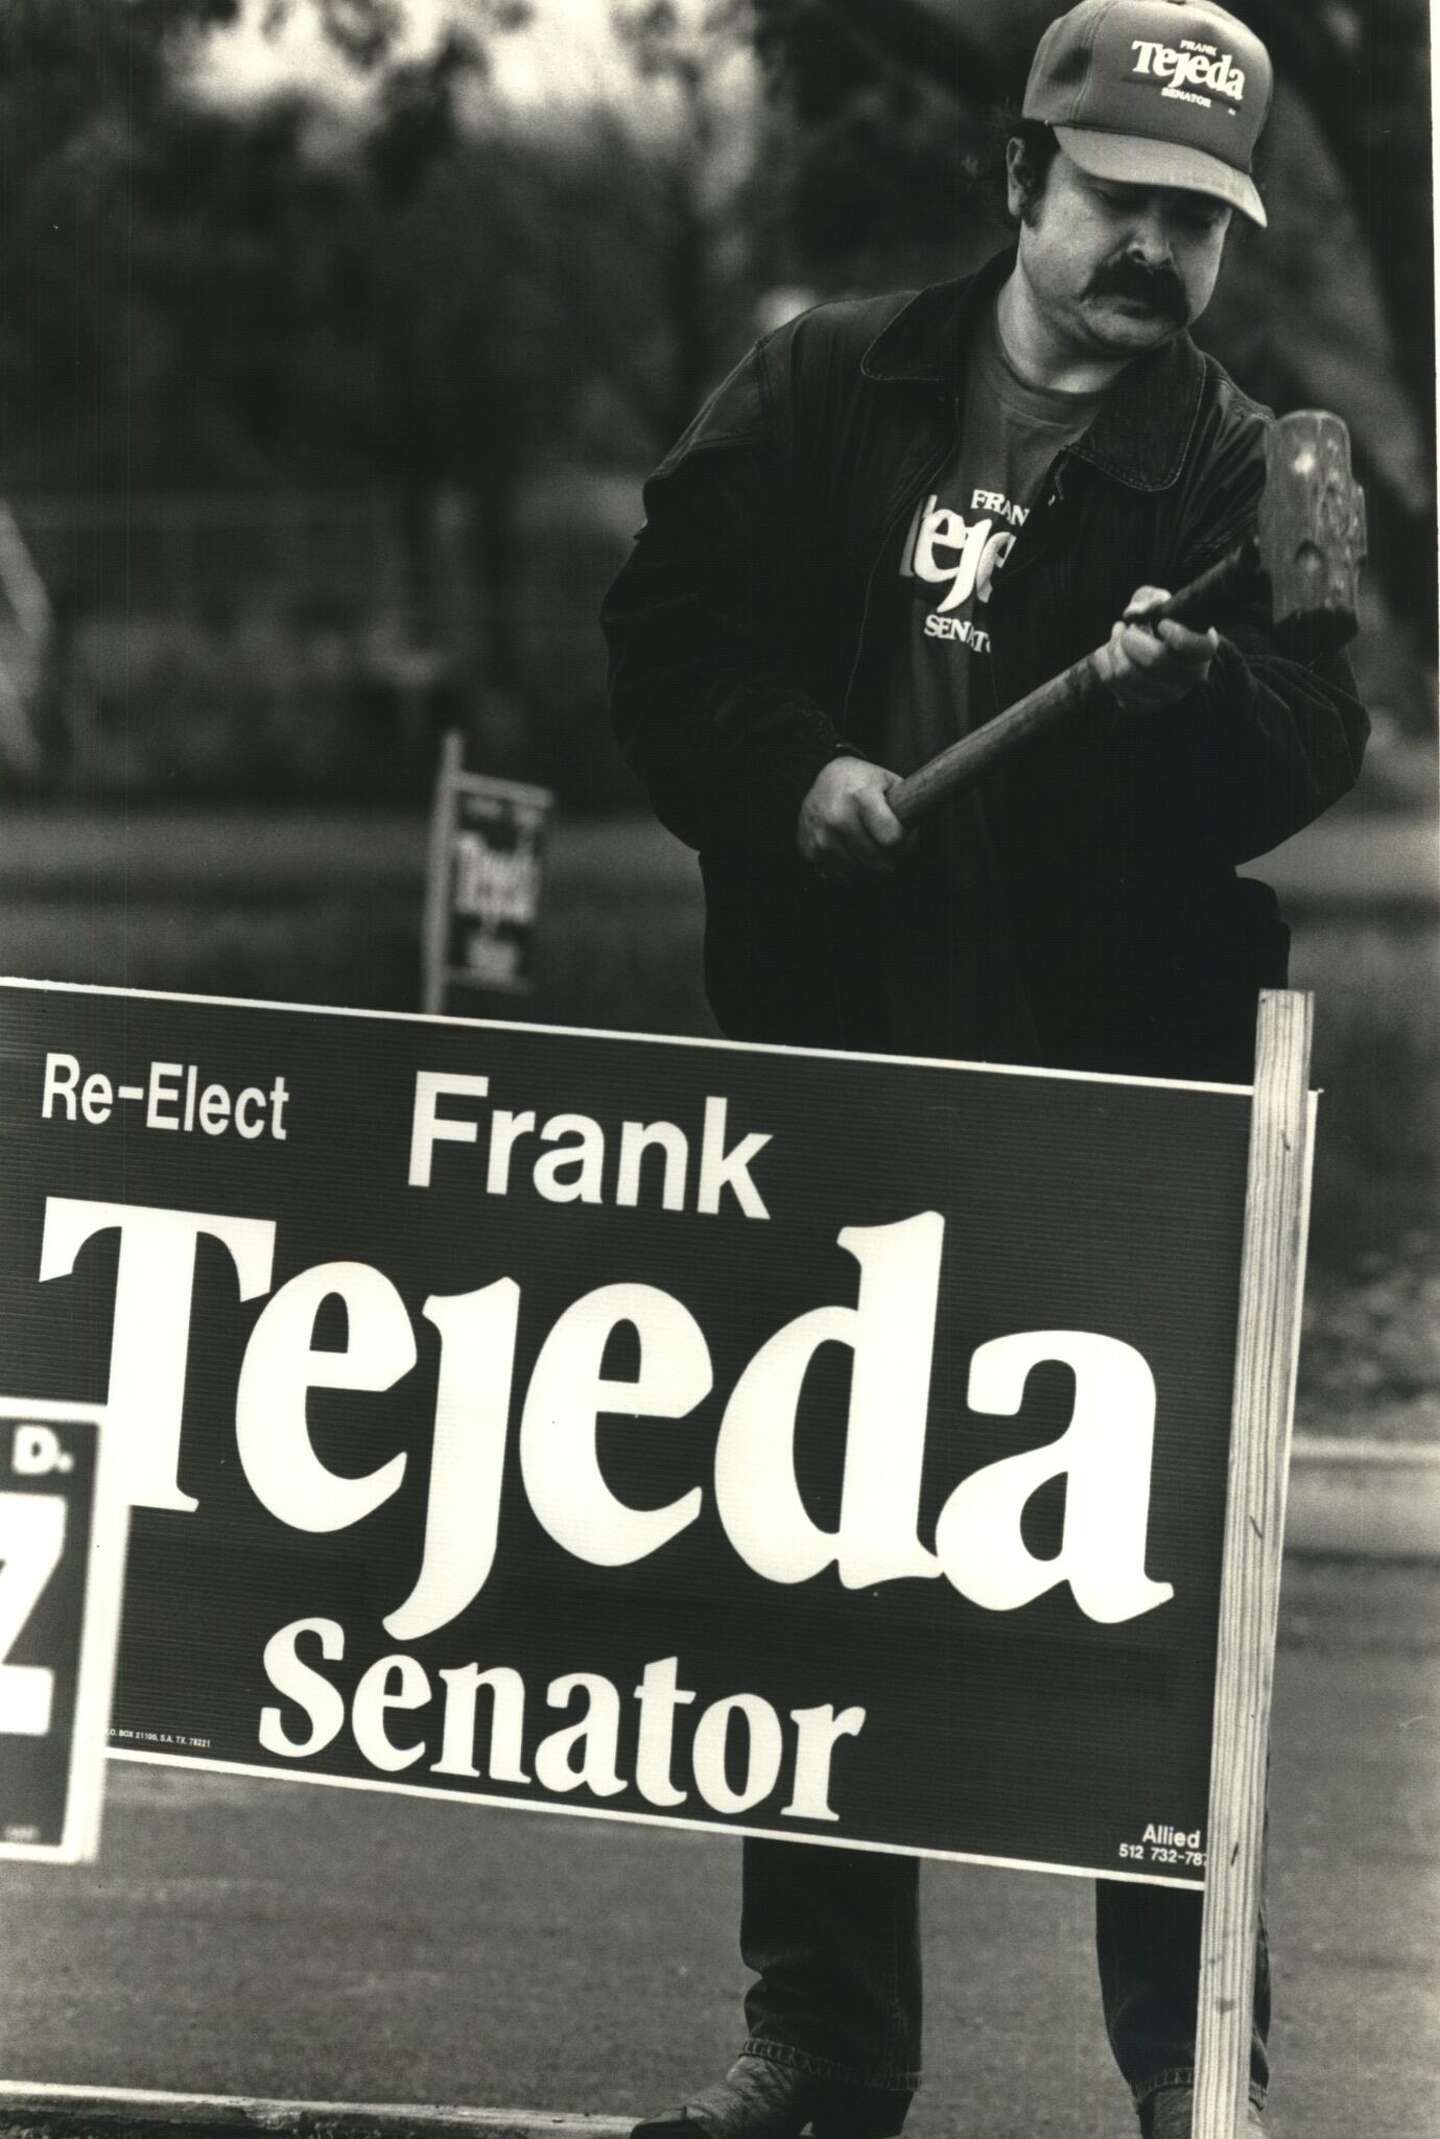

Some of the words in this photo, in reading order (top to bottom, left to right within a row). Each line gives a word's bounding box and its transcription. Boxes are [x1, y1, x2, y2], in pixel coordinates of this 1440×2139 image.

[1131, 40, 1246, 100] Tejeda
[1179, 39, 1218, 57] FRANK
[1161, 86, 1212, 108] SENATOR
[970, 488, 1031, 527] FRAN
[41, 1052, 289, 1140] Re-Elect
[408, 1070, 773, 1220] Frank
[38, 1196, 1175, 1641] Tejeda
[11, 1424, 74, 1475] D.
[258, 1616, 867, 1822] Senator
[1118, 1842, 1145, 1861] 512
[1141, 1823, 1201, 1850] Allied
